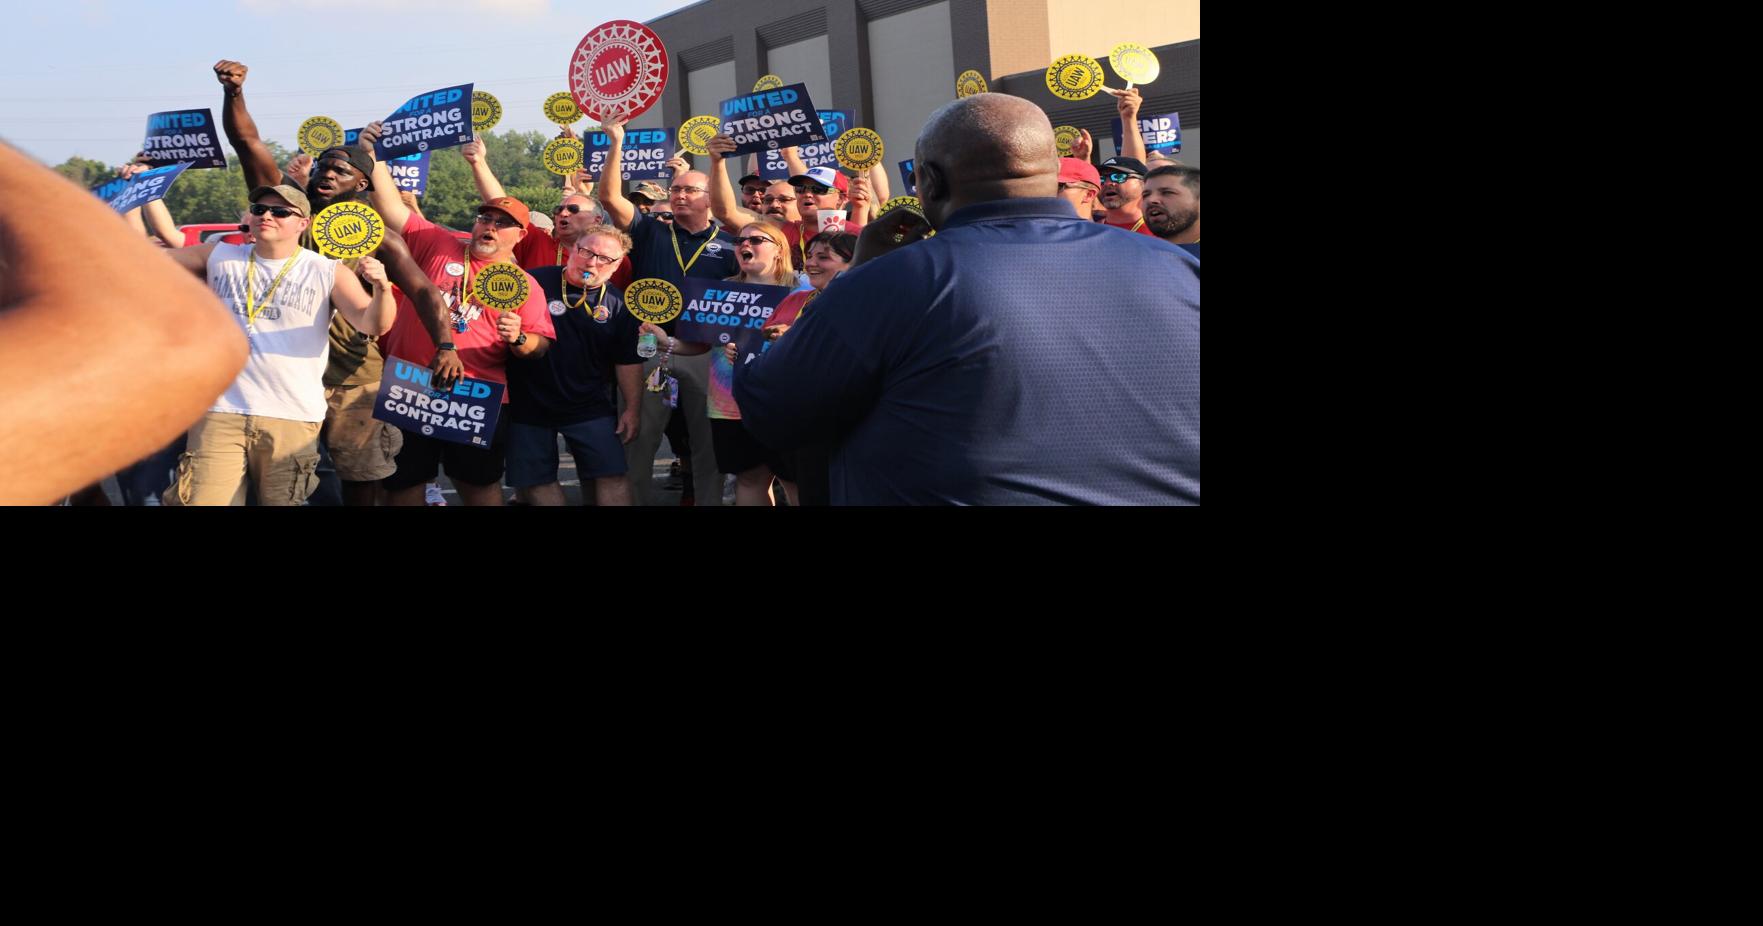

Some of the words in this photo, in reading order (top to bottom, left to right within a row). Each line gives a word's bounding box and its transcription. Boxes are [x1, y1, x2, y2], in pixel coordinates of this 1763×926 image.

[595, 54, 631, 87] UAW
[1066, 66, 1085, 87] UAW
[397, 89, 463, 113] NITED
[555, 104, 573, 113] UAW
[724, 88, 799, 116] UNITED
[382, 107, 462, 136] STRONG
[723, 108, 806, 135] STRONG
[145, 132, 211, 150] STRONG
[382, 122, 465, 148] CONTRACT
[592, 131, 667, 146] UTED
[734, 122, 812, 145] ONTRACT
[1142, 129, 1177, 144] ERS
[144, 147, 216, 160] CONTRACT
[556, 152, 575, 161] UAW
[766, 140, 837, 160] SRONG
[849, 144, 869, 154] UAW
[589, 160, 666, 173] COTRACT
[766, 153, 836, 170] COTRAC
[388, 165, 420, 178] ONG
[334, 221, 362, 239] UAW
[491, 281, 515, 292] UAW
[703, 288, 763, 304] EVERY
[642, 294, 666, 306] UAW
[687, 299, 735, 315] AUTO
[738, 304, 774, 319] JOB
[680, 310, 691, 322] A
[695, 312, 741, 327] GOOD
[744, 319, 765, 330] JO
[394, 361, 491, 399] UNED
[388, 384, 486, 420] STRONG
[384, 399, 485, 434] CONTRACT
